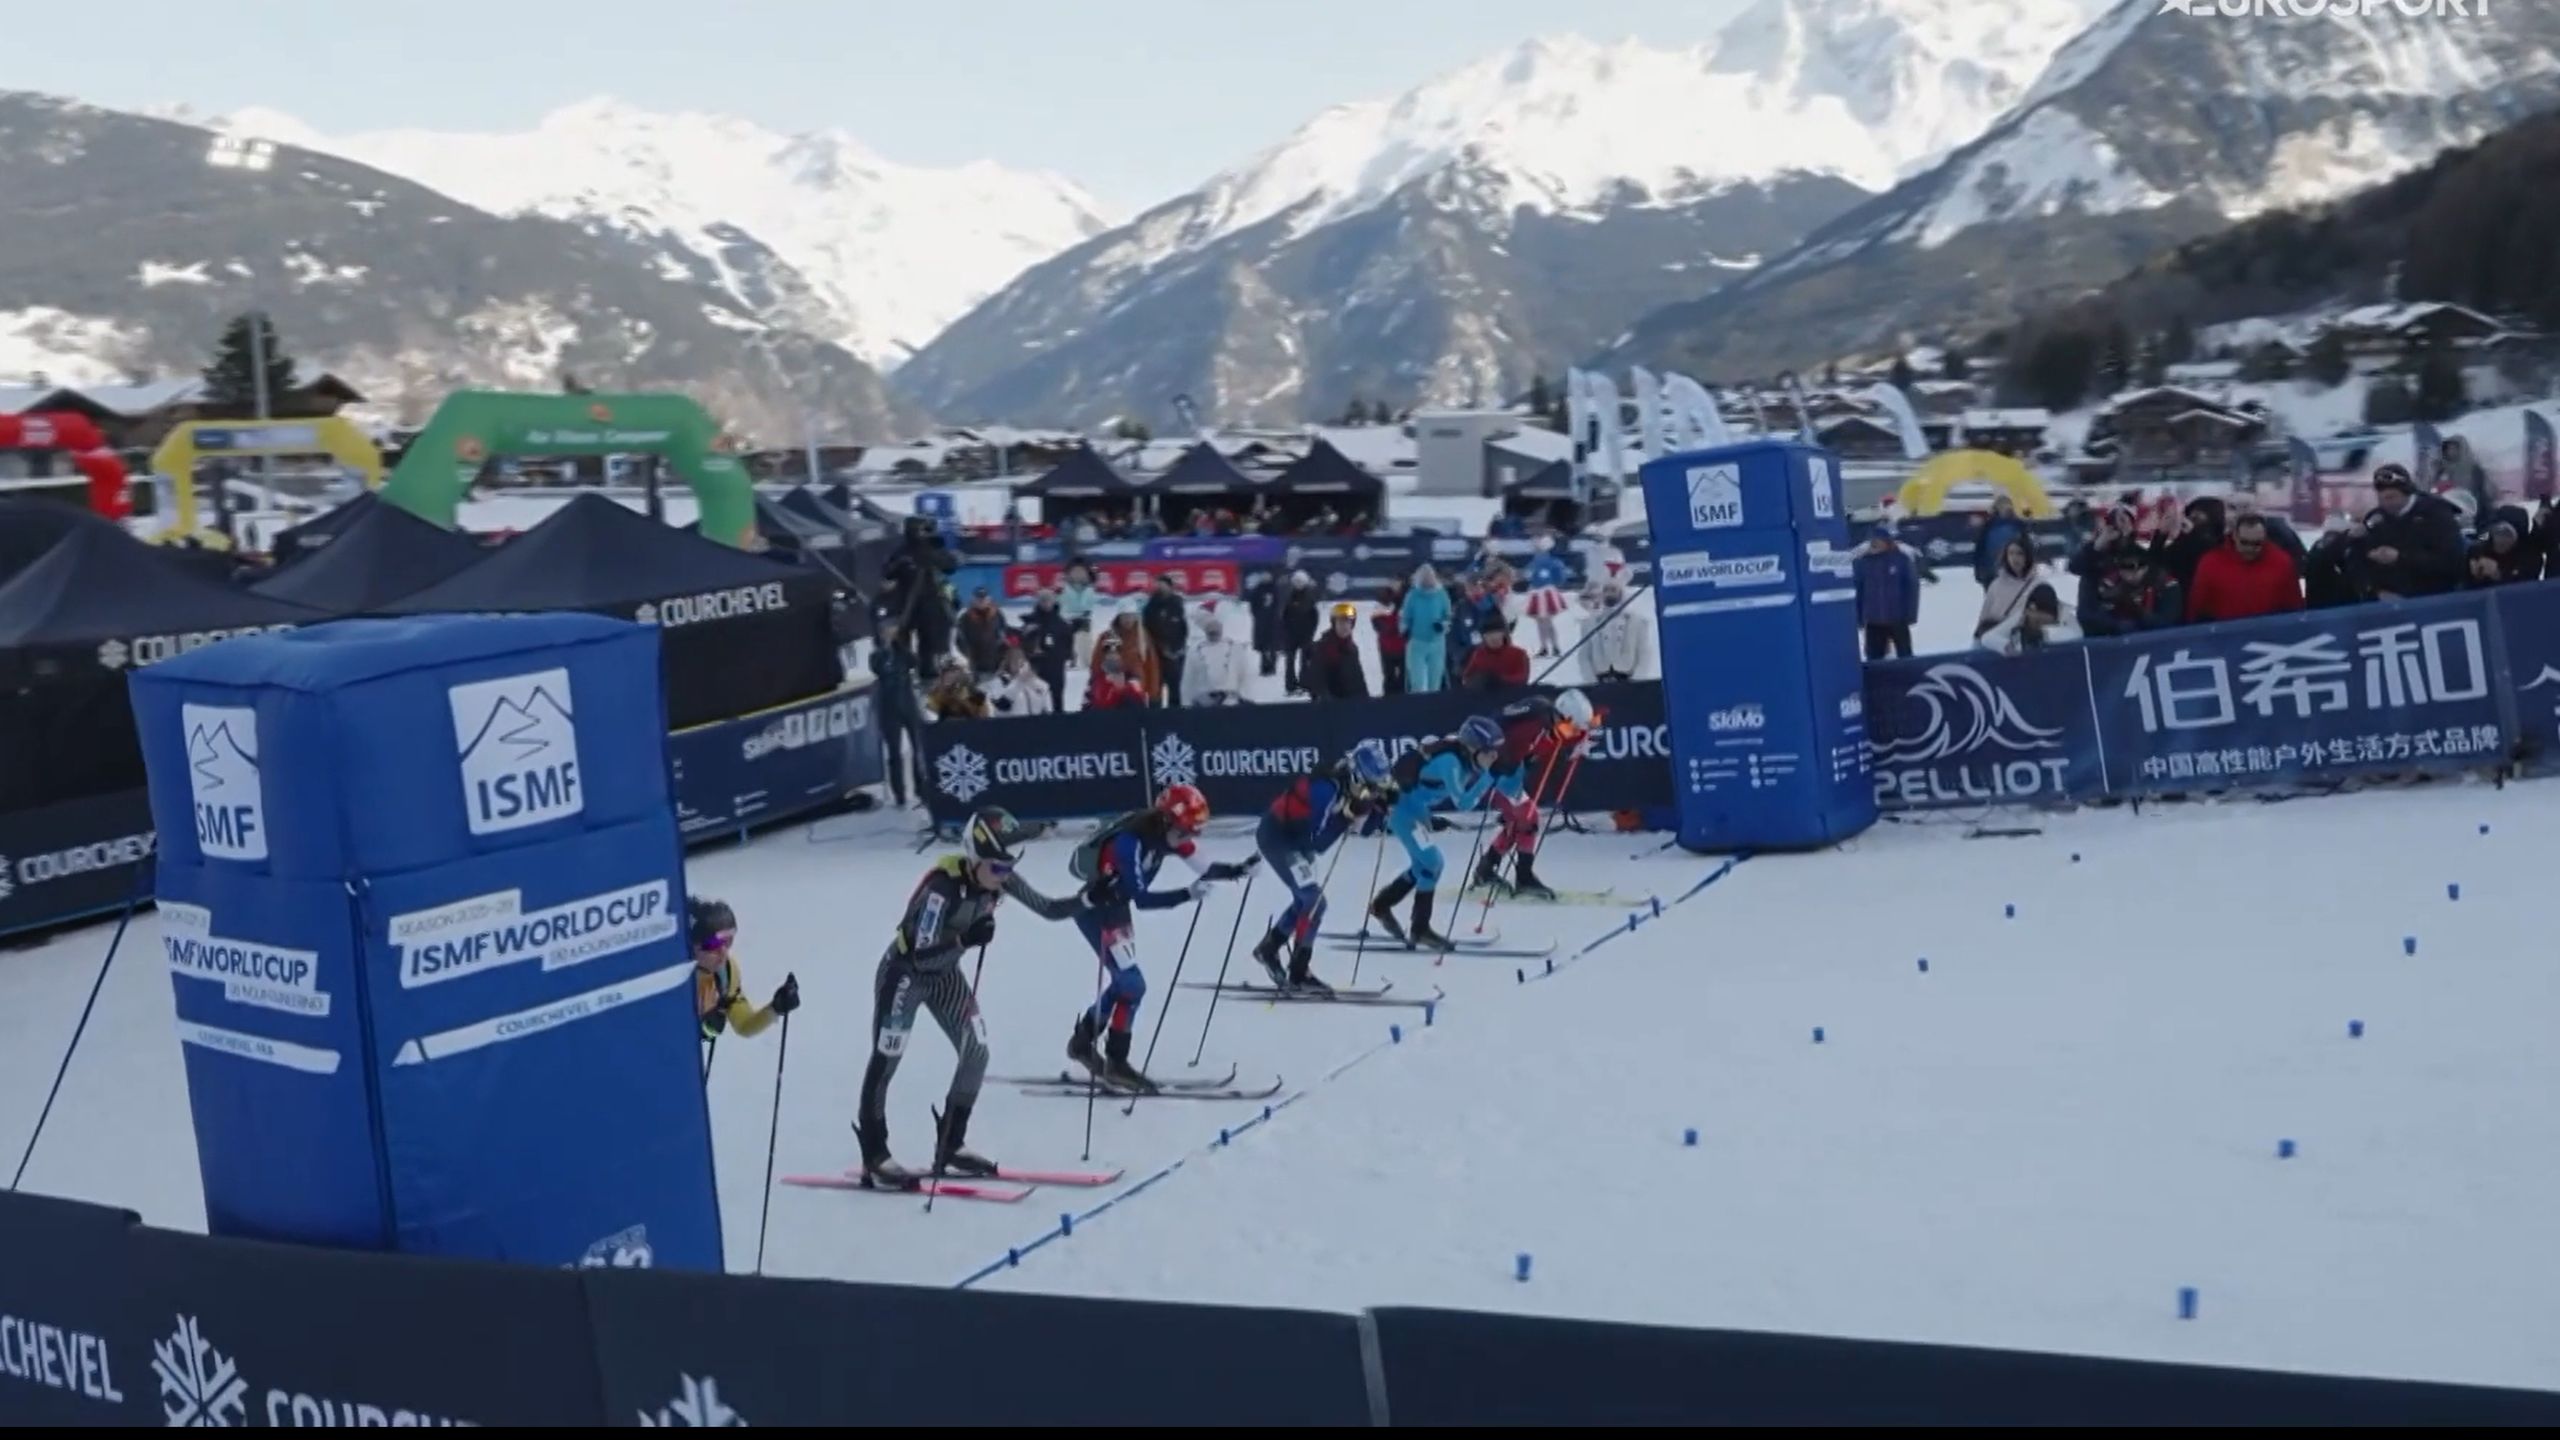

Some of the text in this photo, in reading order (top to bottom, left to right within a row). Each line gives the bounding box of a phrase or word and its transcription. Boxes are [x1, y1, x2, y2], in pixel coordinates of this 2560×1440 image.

[1693, 501, 1739, 523] ISMF
[1698, 561, 1744, 579] WORLD
[1744, 559, 1775, 575] CUP
[660, 581, 790, 627] COURCHEVEL
[2124, 618, 2488, 733] 伯希和
[995, 750, 1137, 783] COURCHEVEL
[2143, 725, 2500, 780] 中国高性能户外生活方式品牌
[477, 761, 577, 821] ISMF
[1873, 758, 2071, 806] PELLIOT
[410, 888, 661, 977] ISMF WORLD CUP
[198, 943, 263, 978] WORLD
[265, 955, 309, 986] CUP
[0, 1315, 123, 1403] CHEVEL
